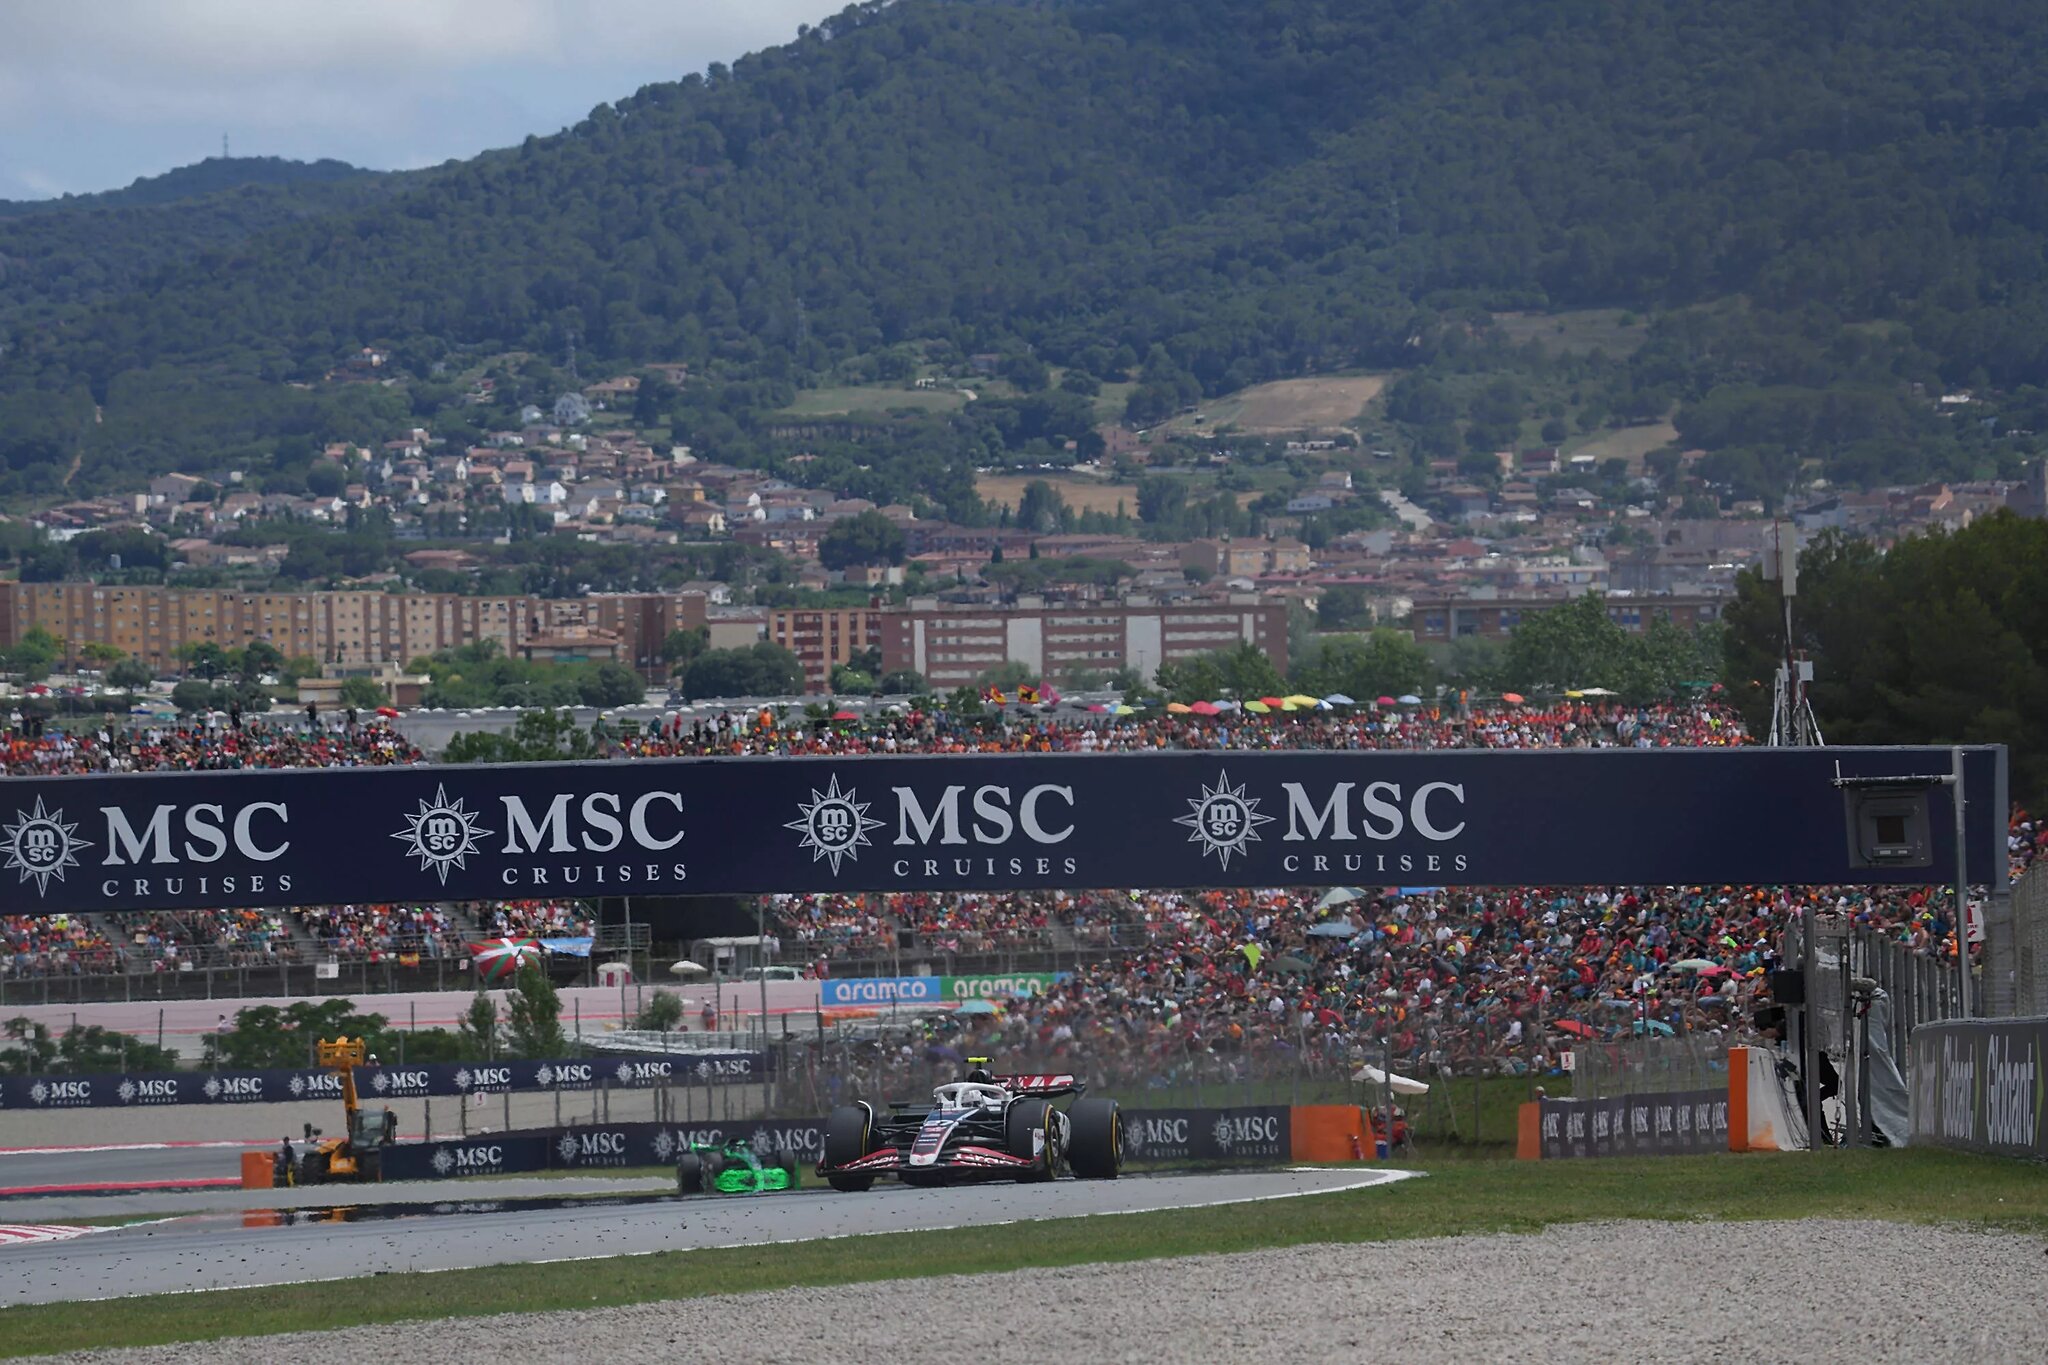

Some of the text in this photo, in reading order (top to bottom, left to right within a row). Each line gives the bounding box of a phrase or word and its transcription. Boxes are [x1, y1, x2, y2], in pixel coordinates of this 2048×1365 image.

[891, 784, 1075, 845] MSC
[1281, 782, 1466, 841] MSC
[499, 791, 685, 854] MSC
[99, 801, 290, 866] MSC
[502, 863, 686, 884] CRUISES
[894, 857, 1076, 877] CRUISES
[1283, 854, 1467, 873] CRUISES
[103, 874, 292, 897] CRUISES
[836, 981, 927, 1000] aramco
[474, 1067, 511, 1085] MSC
[555, 1065, 592, 1082] MSC
[635, 1062, 672, 1079] MSC
[714, 1059, 751, 1075] MSC
[51, 1081, 91, 1098] MSC
[138, 1080, 177, 1096] MSC
[223, 1078, 262, 1094] MSC
[307, 1073, 344, 1090] MSC
[391, 1071, 429, 1089] MSC
[1986, 1033, 2034, 1147] Globant
[774, 1127, 818, 1150] MSC
[1147, 1118, 1188, 1143] MSC
[1234, 1116, 1279, 1142] MSC
[582, 1132, 625, 1155] MSC
[456, 1146, 502, 1167] MSC
